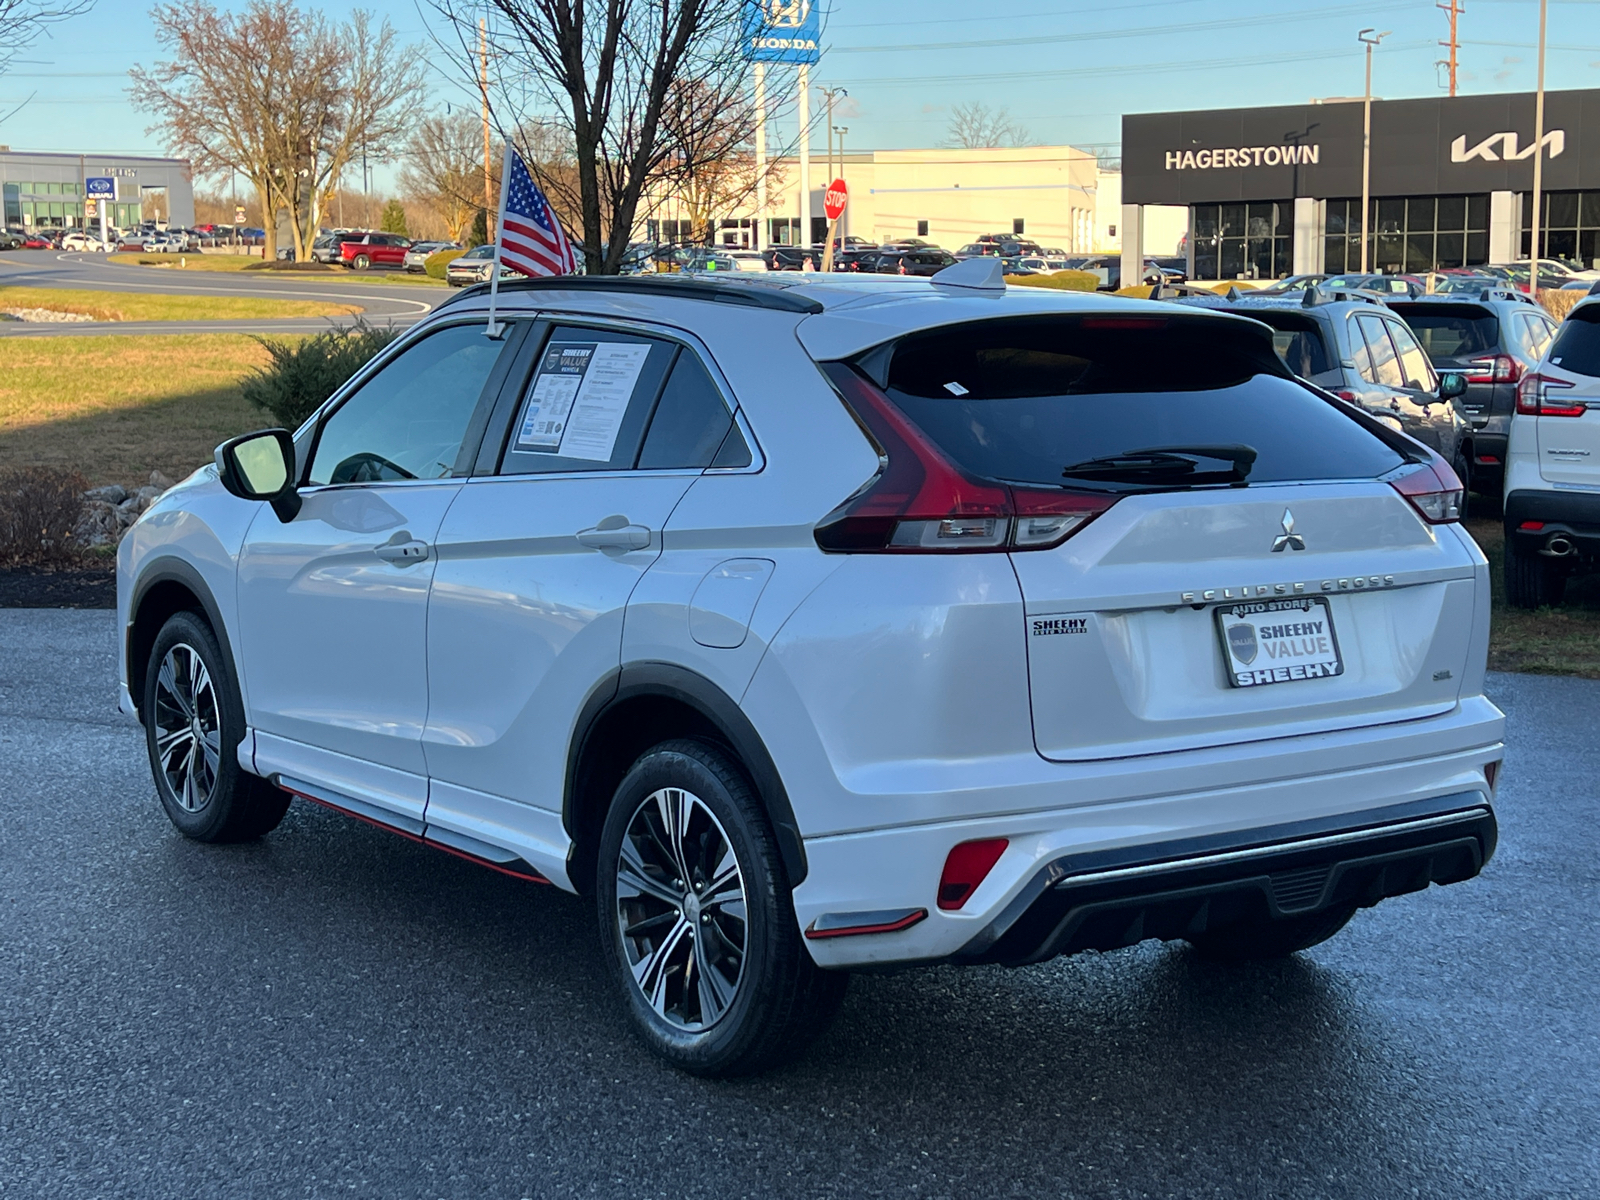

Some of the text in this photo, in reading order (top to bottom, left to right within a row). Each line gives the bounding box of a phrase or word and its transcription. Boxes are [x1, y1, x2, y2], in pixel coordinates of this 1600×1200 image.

[751, 36, 818, 50] HONDA
[1451, 129, 1564, 162] KIA
[1165, 144, 1319, 170] HAGERSTOWN
[826, 190, 847, 208] STOP
[560, 356, 589, 367] VALUE
[562, 349, 592, 357] SHEEHY
[1181, 575, 1394, 601] ECLIPSE CROSS
[1231, 599, 1316, 615] AUTO STORES
[1033, 619, 1087, 630] SHEEHY
[1260, 621, 1323, 639] SHEEHY
[1262, 637, 1330, 659] VALUE
[1236, 661, 1339, 686] SHEEHY
